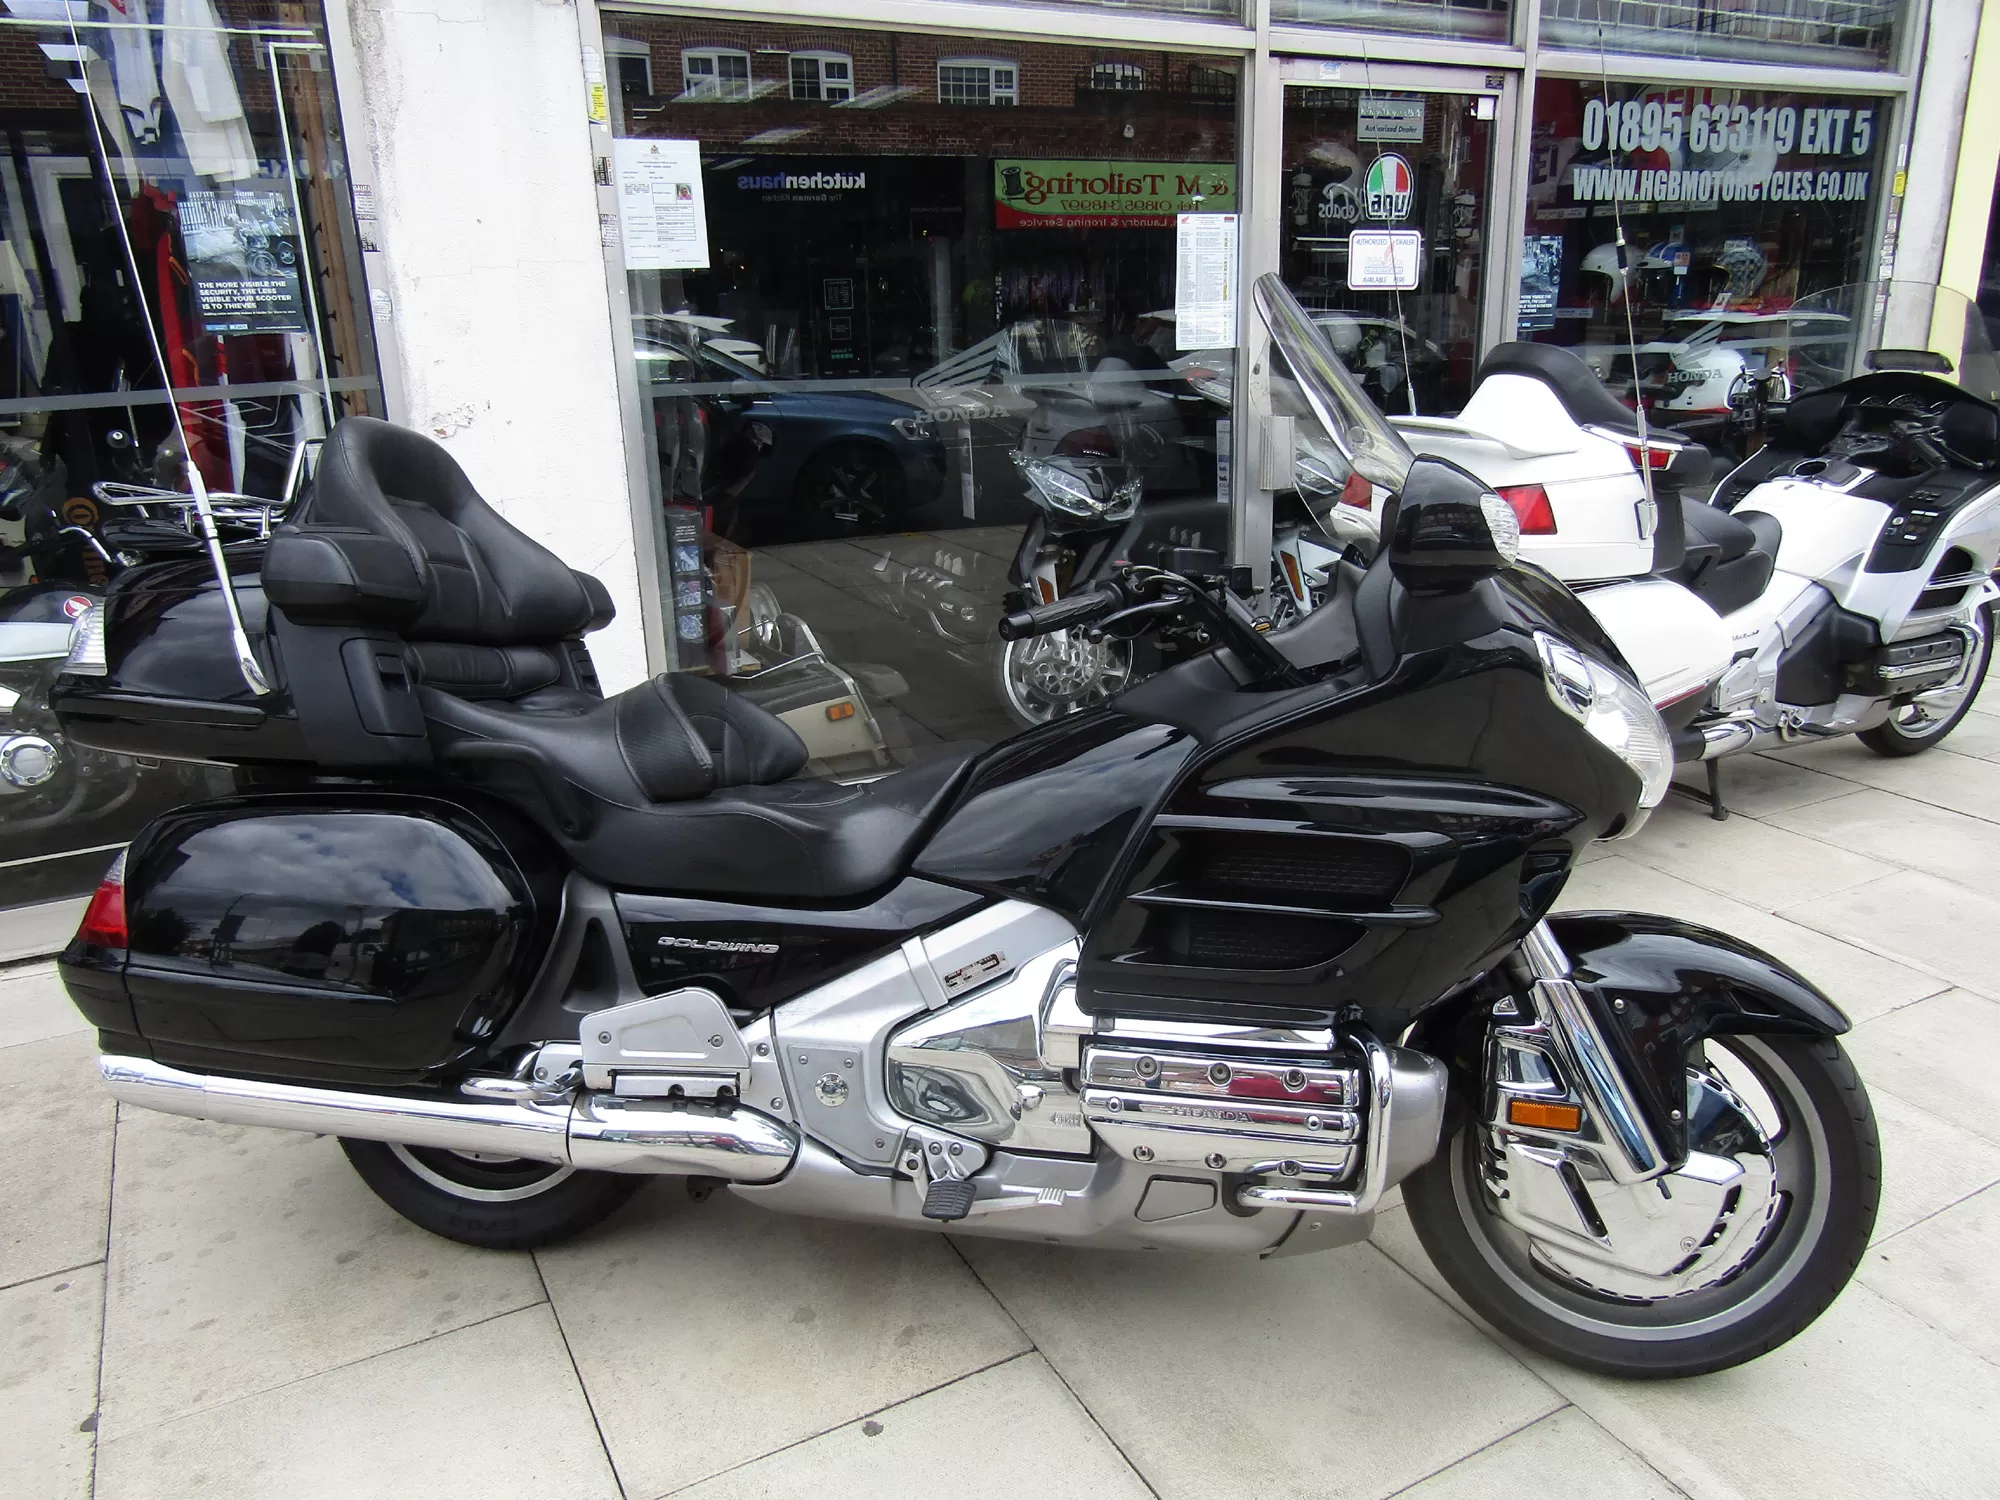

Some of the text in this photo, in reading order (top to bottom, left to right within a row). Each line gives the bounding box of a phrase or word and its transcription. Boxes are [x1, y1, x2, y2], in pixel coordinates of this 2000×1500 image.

[1582, 100, 1872, 155] 01895 633119 EXT 5
[1573, 168, 1869, 201] WWW.HGBMOTORCYCLES.CO.UK
[1667, 368, 1723, 384] HONDA
[913, 406, 1011, 423] HONDA
[657, 936, 780, 954] GOLDWING
[1171, 1105, 1254, 1124] HONDA
